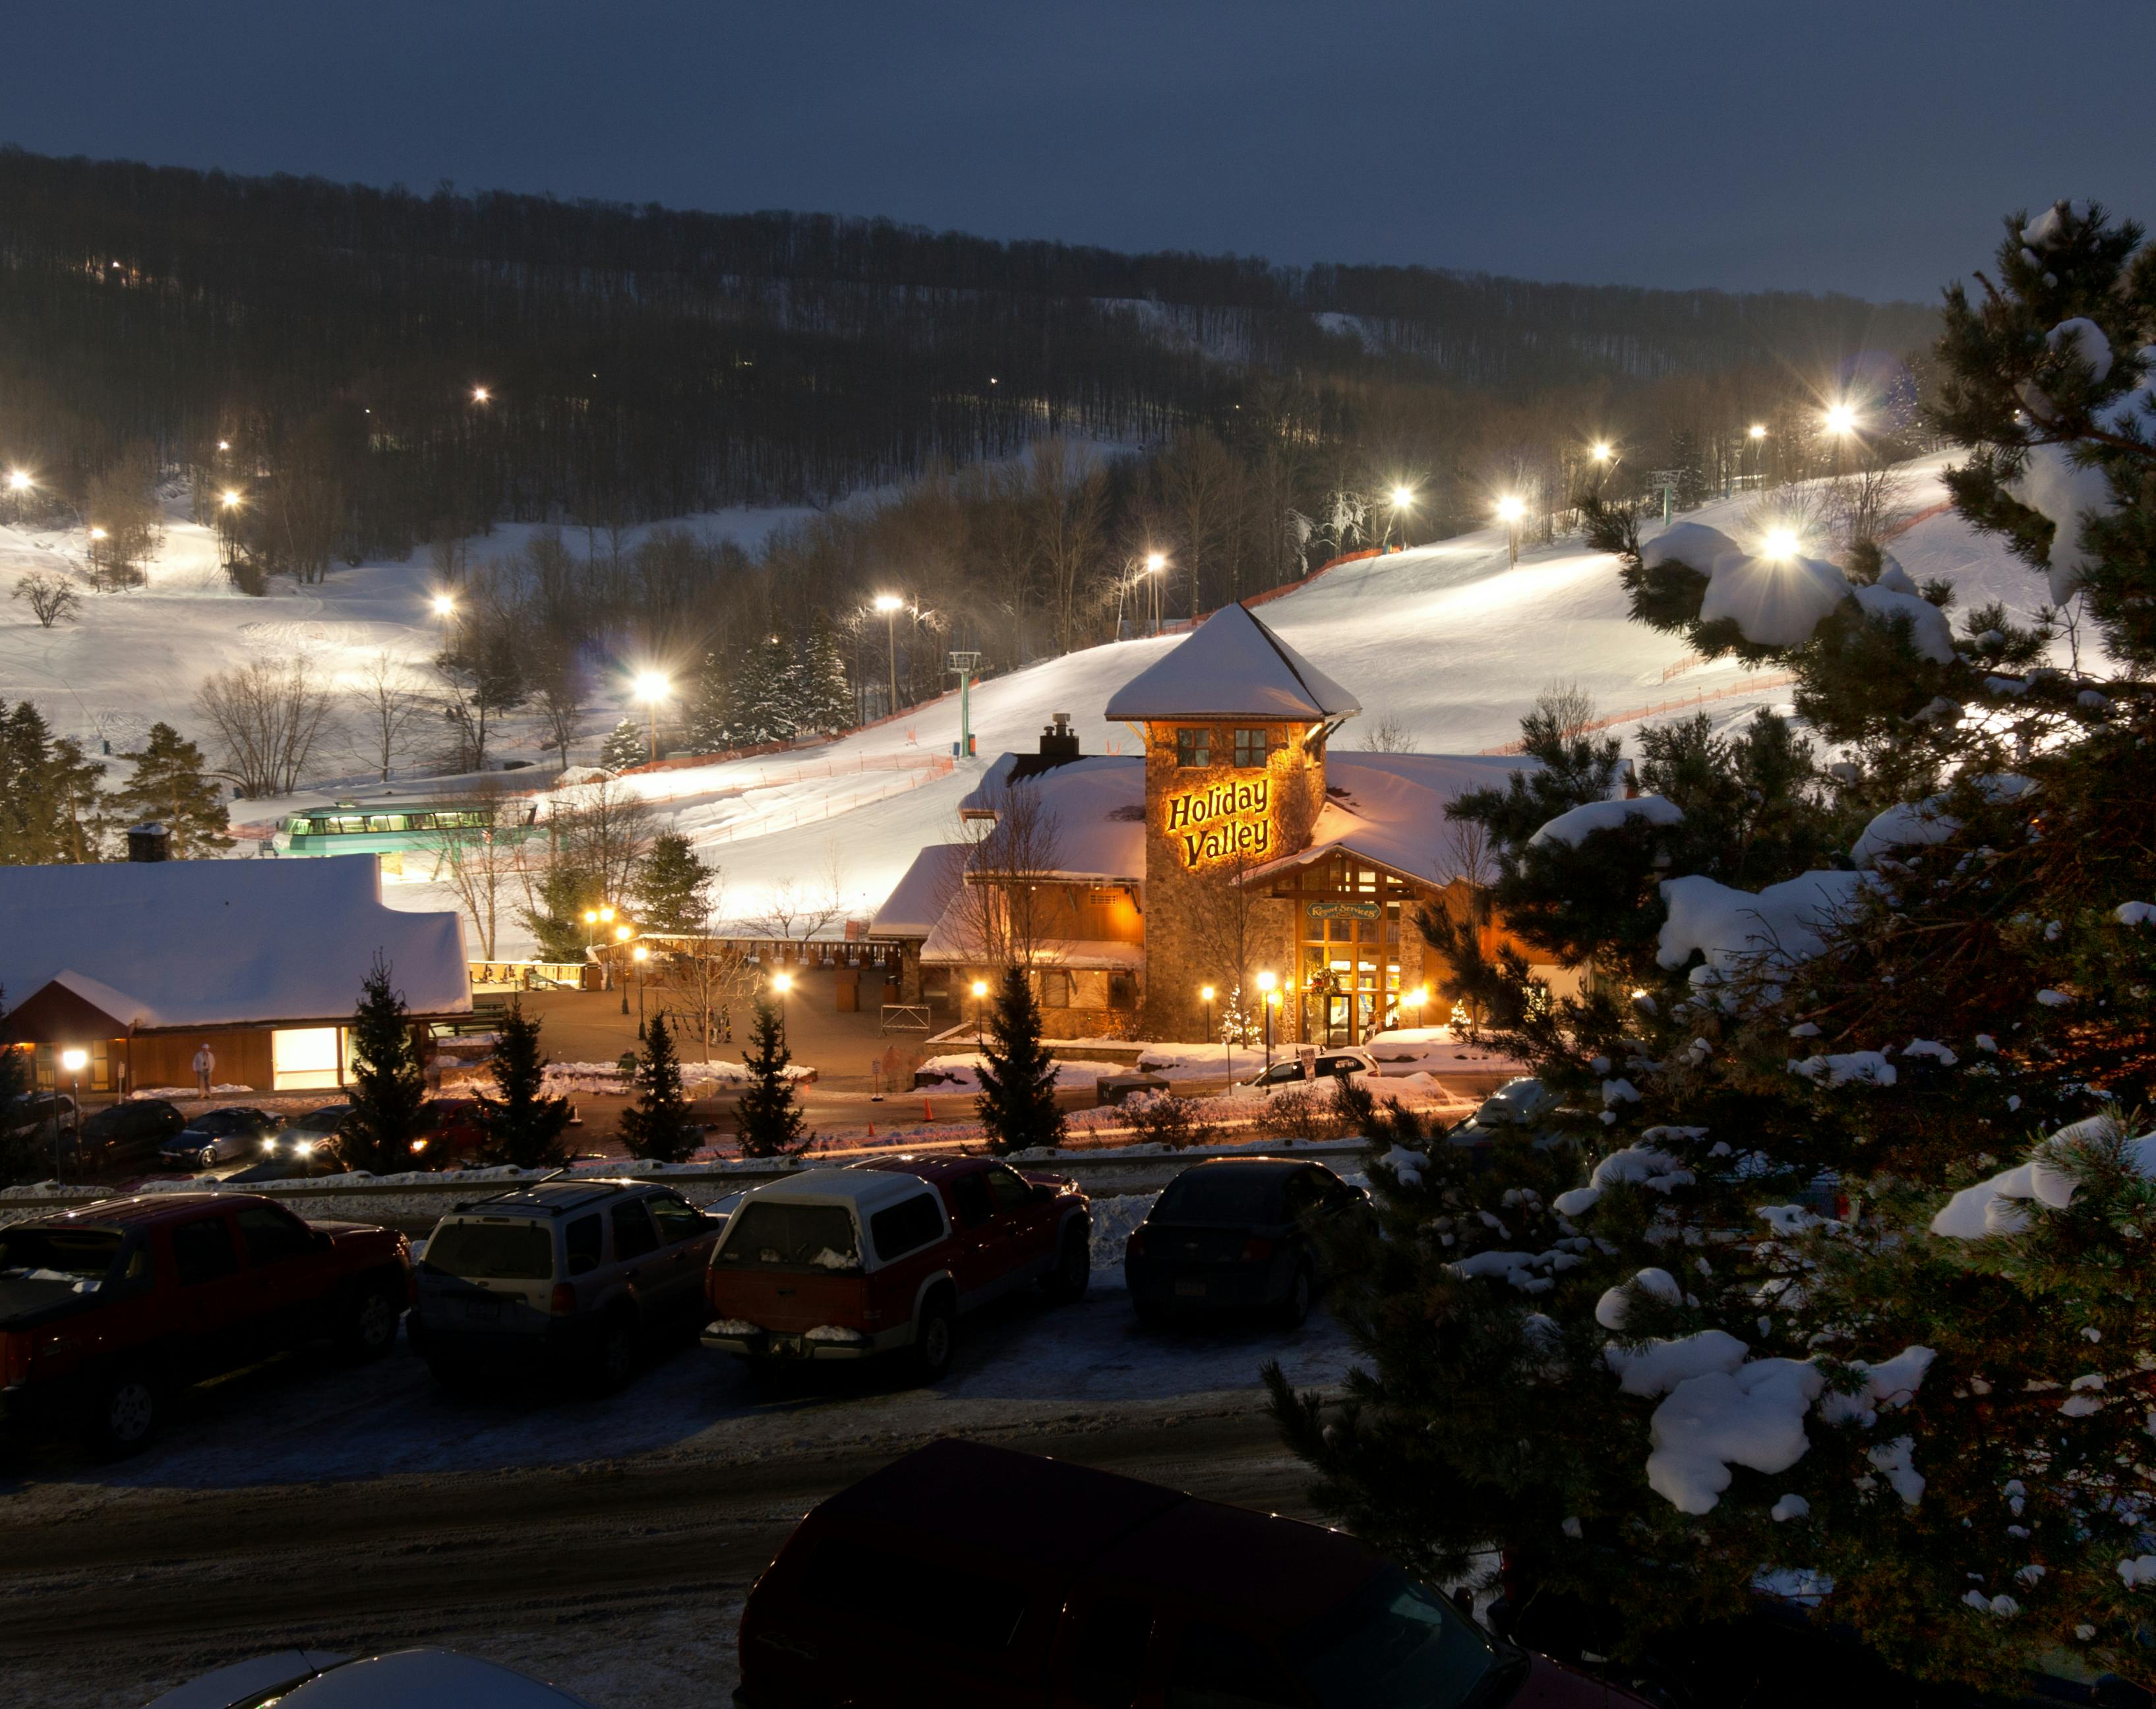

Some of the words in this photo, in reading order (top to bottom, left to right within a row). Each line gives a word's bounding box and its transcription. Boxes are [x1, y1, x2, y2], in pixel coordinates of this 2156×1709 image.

[1167, 779, 1269, 831] Holiday
[1184, 820, 1269, 866] Valley
[1339, 904, 1377, 918] Services
